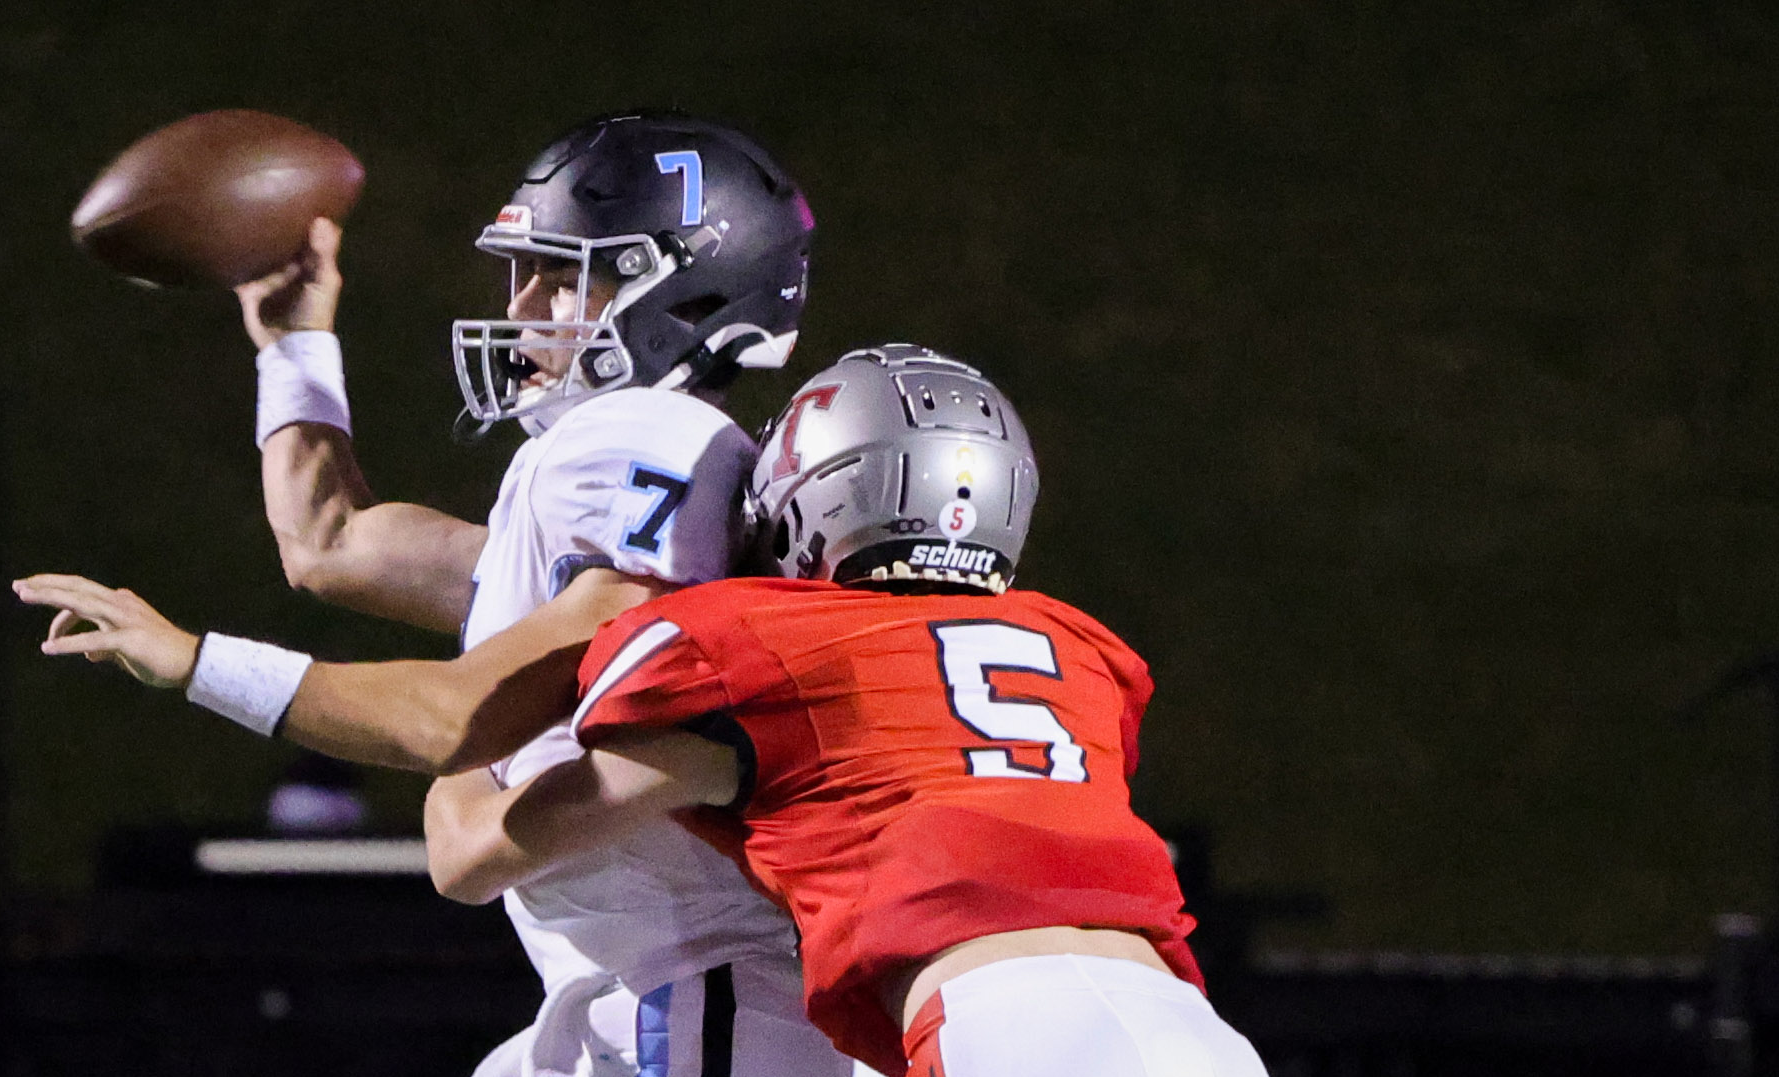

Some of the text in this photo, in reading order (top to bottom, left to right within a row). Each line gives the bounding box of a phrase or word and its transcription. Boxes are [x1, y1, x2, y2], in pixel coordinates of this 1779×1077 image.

[654, 150, 703, 226] 7
[770, 381, 847, 483] T
[619, 460, 695, 560] 7
[949, 506, 965, 531] 5
[908, 540, 997, 574] schutt
[927, 617, 1091, 784] 5
